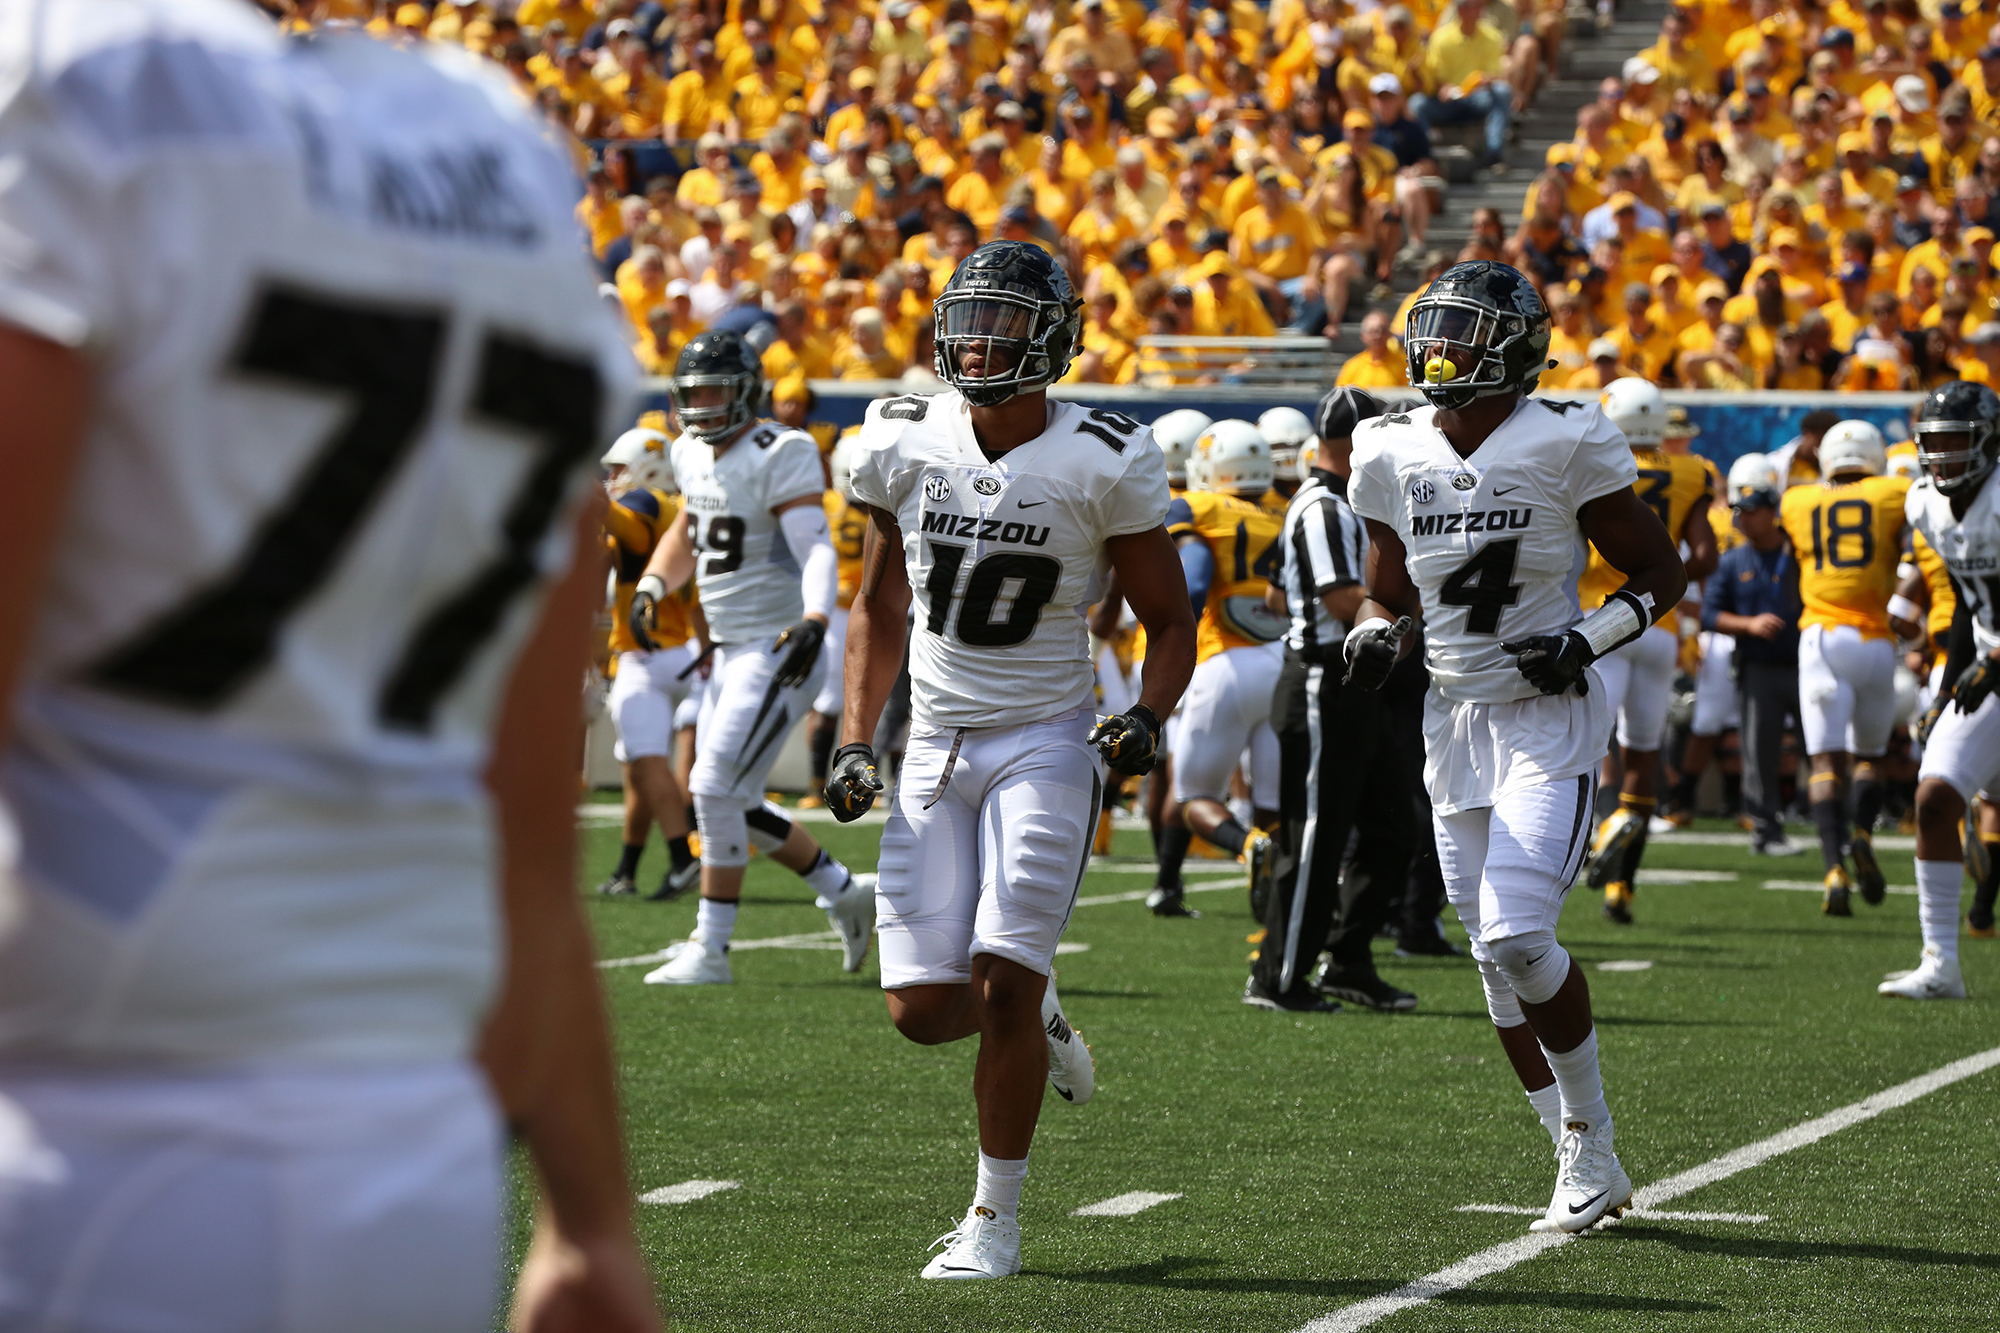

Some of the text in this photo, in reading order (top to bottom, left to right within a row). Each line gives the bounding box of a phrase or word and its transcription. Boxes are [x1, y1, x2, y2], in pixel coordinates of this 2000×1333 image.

[880, 392, 932, 422] 0
[1074, 408, 1140, 456] 10
[88, 276, 606, 736] 77
[926, 476, 950, 502] SEC
[1412, 480, 1434, 503] SEC
[921, 511, 1050, 546] MIZZOU
[1412, 508, 1532, 536] MIZZOU
[1811, 499, 1872, 571] 18
[925, 540, 1063, 649] 10
[1439, 535, 1527, 637] 4
